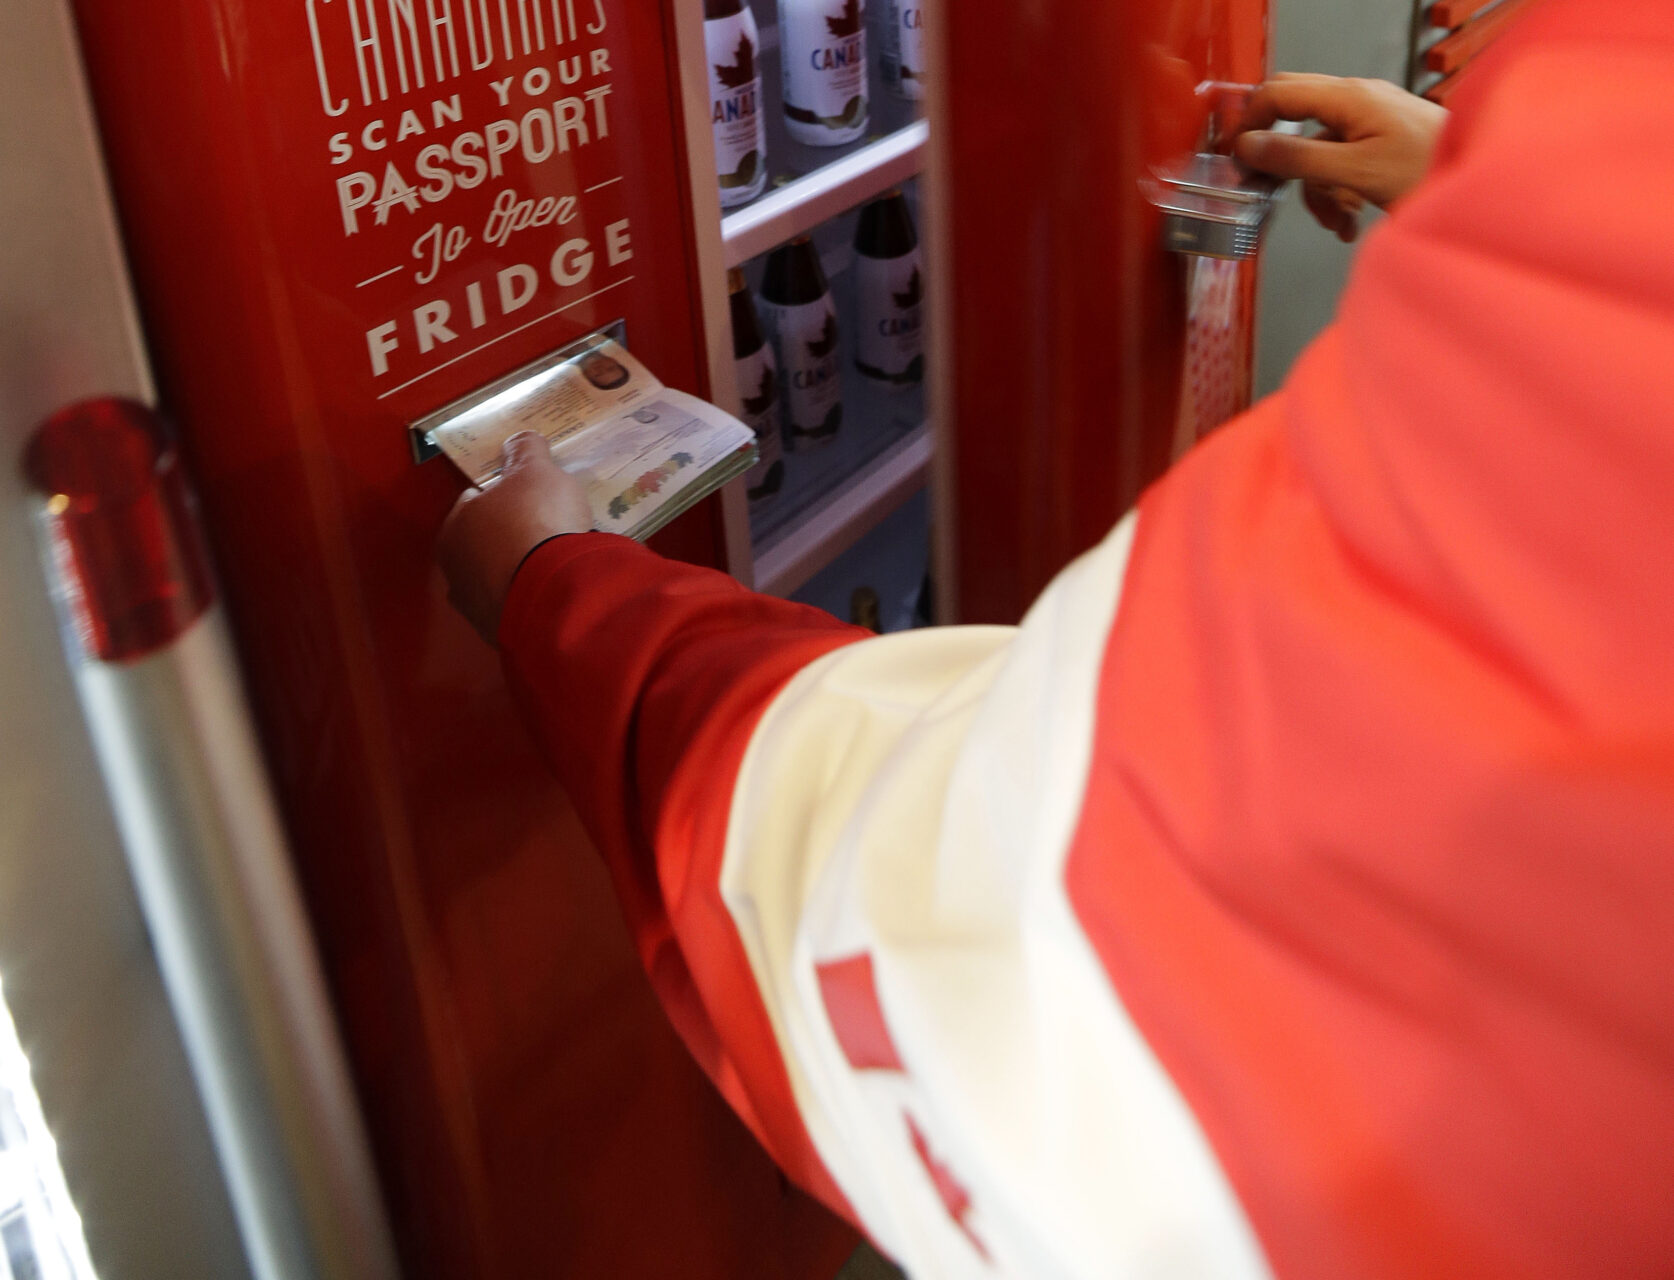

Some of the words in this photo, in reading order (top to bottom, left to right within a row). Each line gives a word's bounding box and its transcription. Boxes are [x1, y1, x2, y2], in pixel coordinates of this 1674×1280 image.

[330, 94, 463, 165] SCAN
[489, 48, 613, 108] YOUR
[336, 84, 613, 237] PASSPORT
[365, 218, 634, 378] FRIDGE
[411, 223, 472, 285] To
[483, 188, 579, 248] Open
